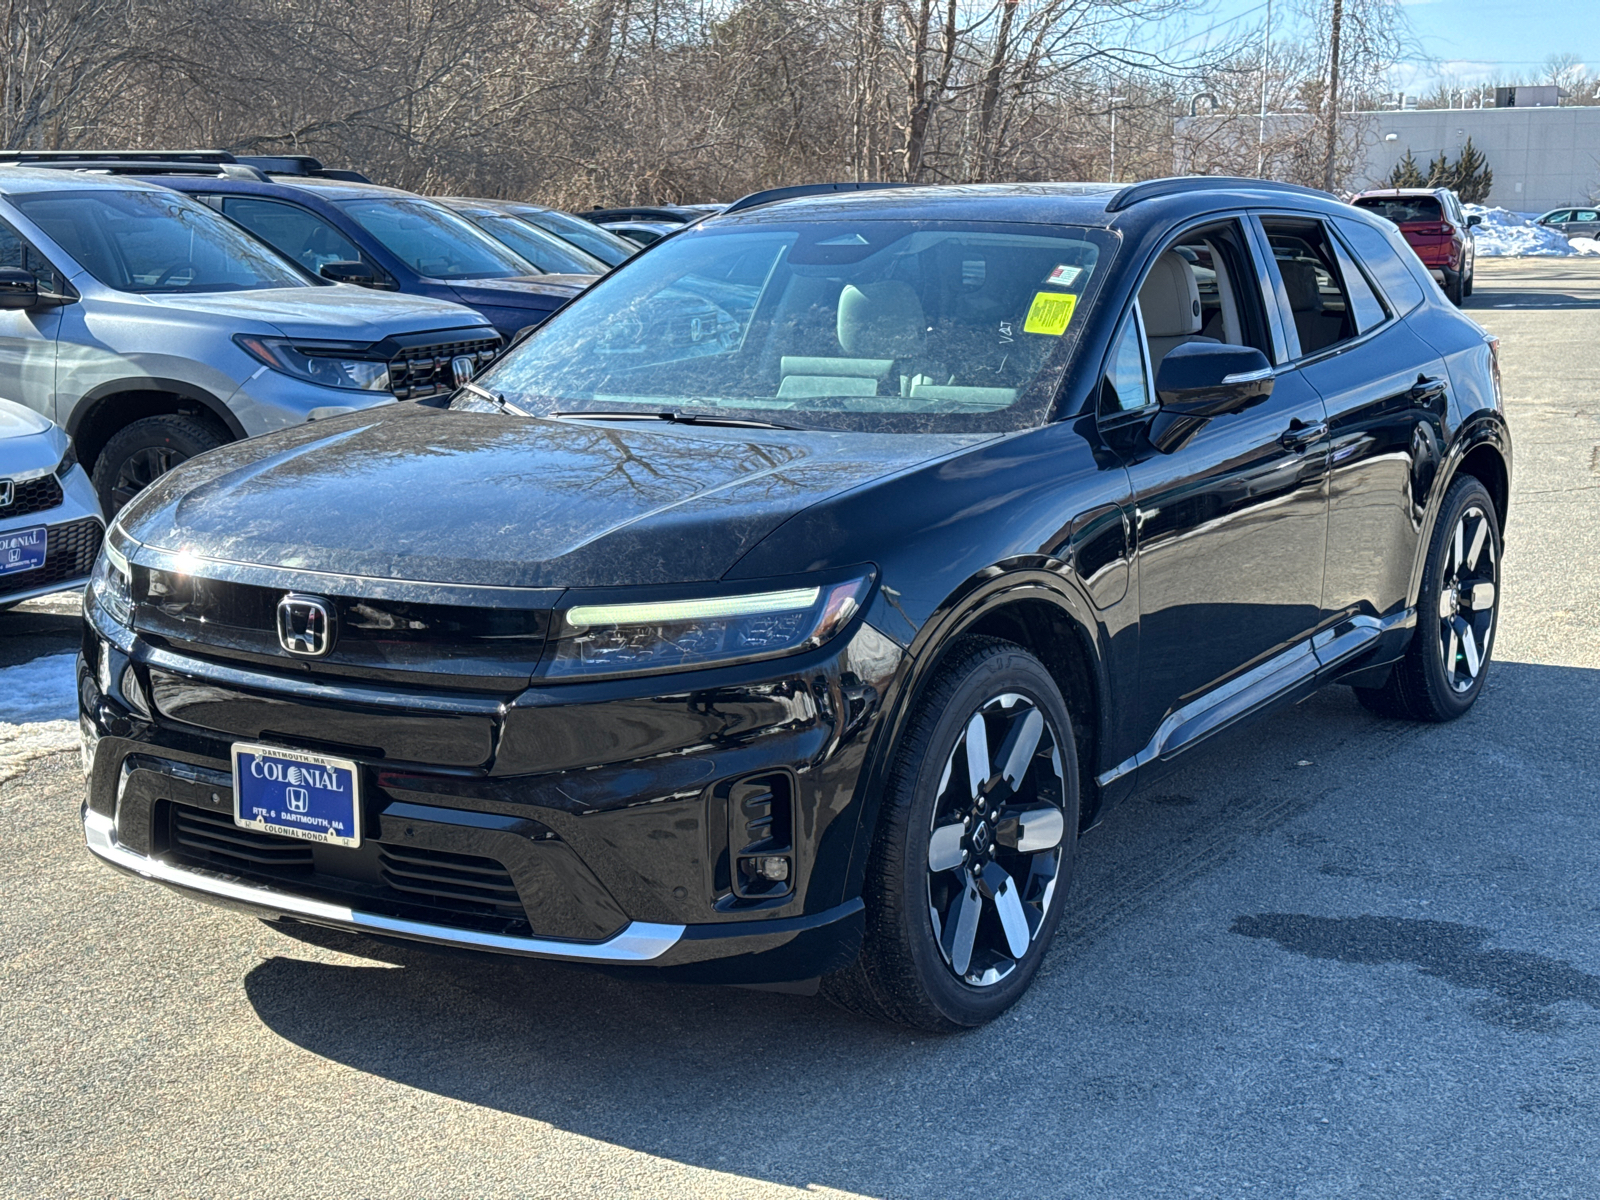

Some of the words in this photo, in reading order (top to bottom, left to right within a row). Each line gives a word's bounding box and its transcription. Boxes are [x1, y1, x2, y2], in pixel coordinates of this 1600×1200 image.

[0, 534, 40, 550] OLONIAL
[314, 757, 326, 765] MA
[250, 759, 344, 792] COLONIAL
[252, 806, 269, 817] RTE.
[270, 810, 276, 818] 6
[332, 821, 344, 830] MA
[264, 825, 300, 837] COLONIAL
[301, 831, 328, 843] HONDA
